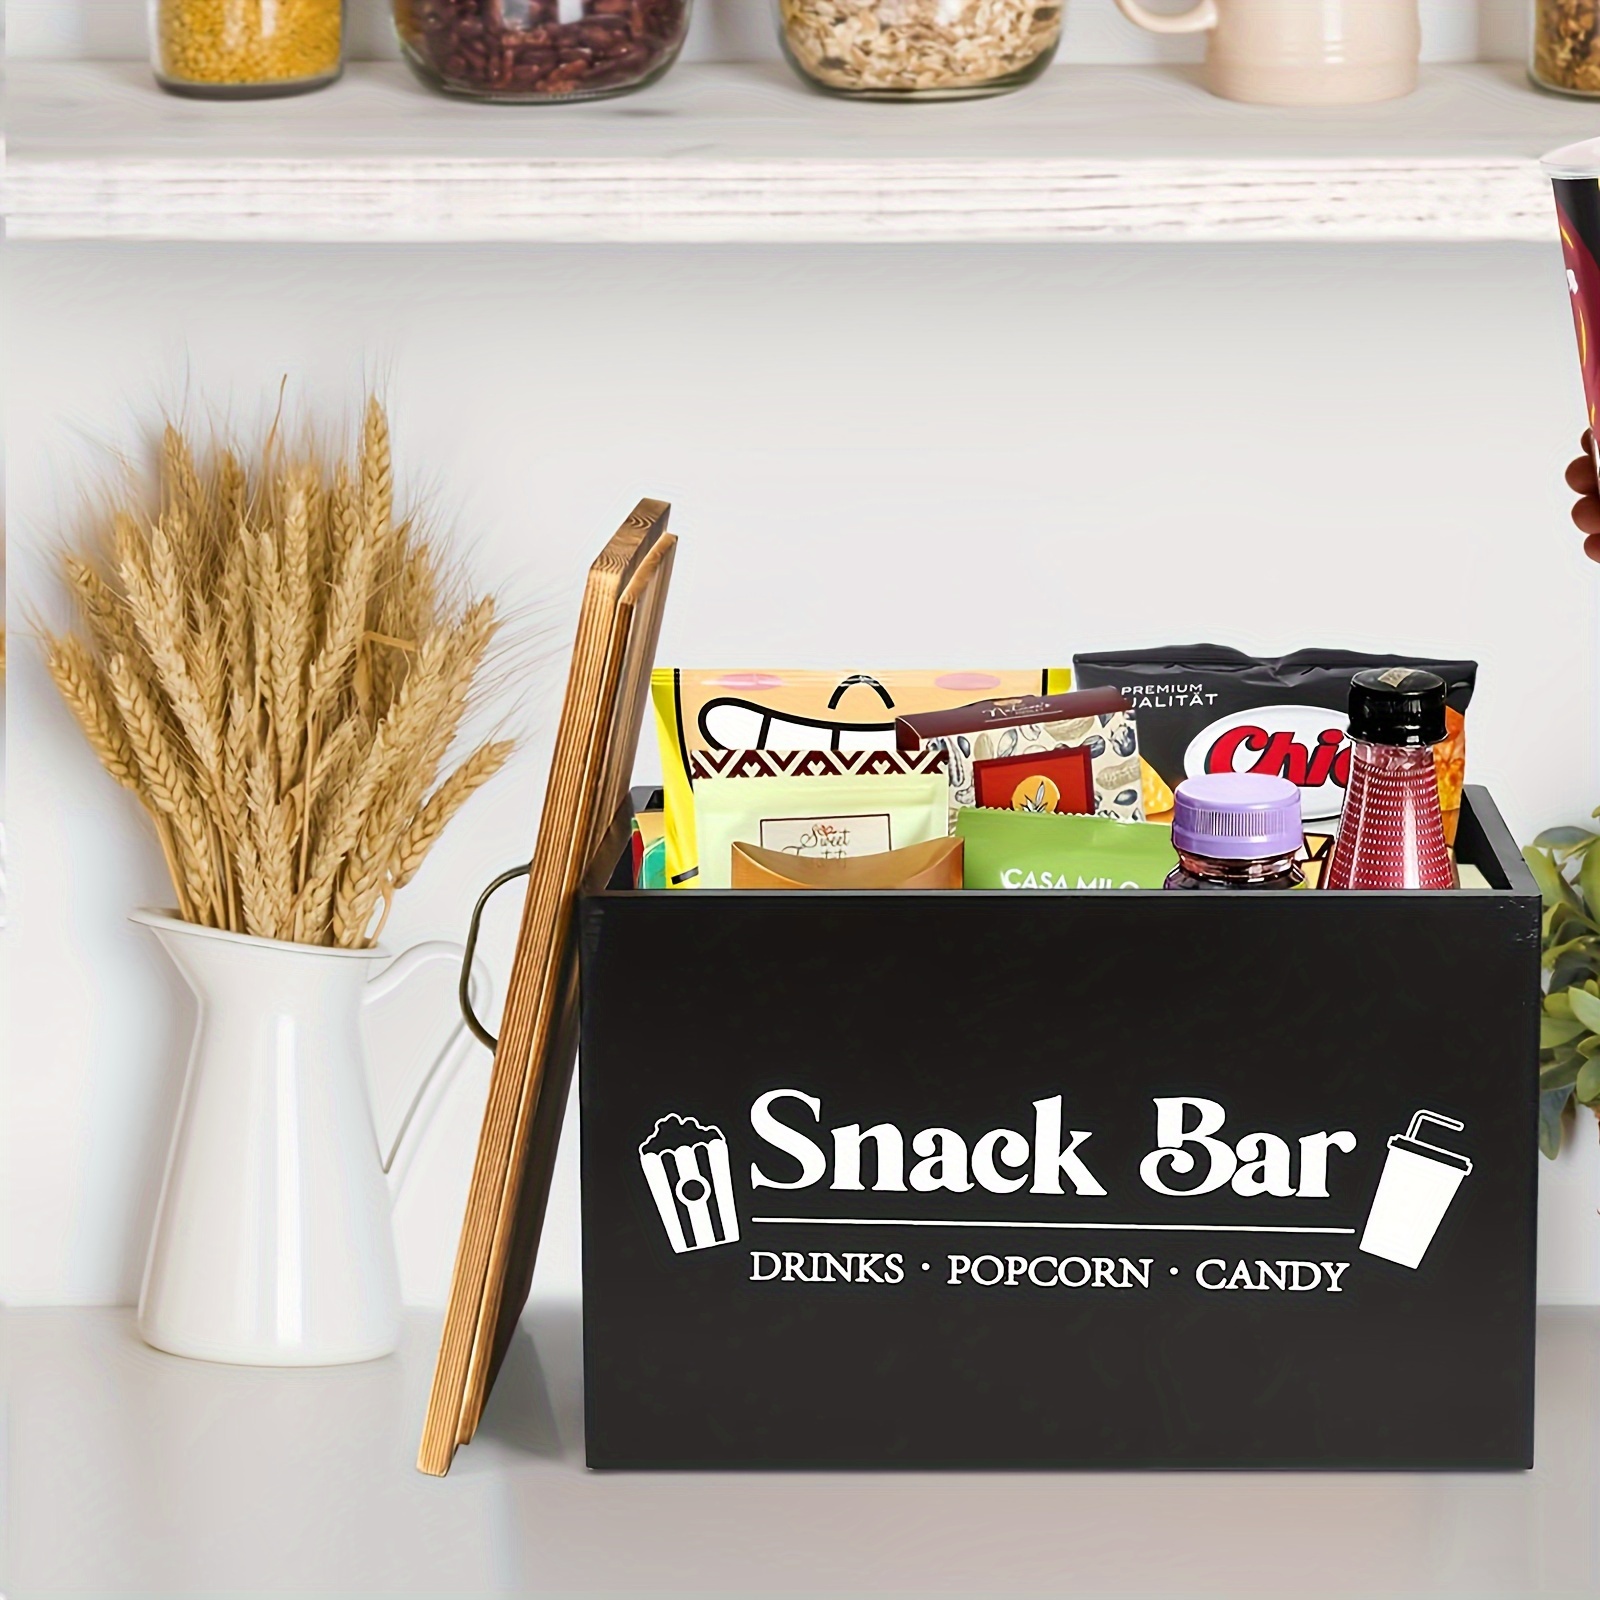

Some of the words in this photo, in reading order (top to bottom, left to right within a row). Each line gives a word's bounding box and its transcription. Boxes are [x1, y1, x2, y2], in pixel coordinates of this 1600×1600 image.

[1121, 683, 1203, 696] PREMIUM
[1131, 692, 1219, 708] ALITÄT
[800, 823, 851, 849] Sweet
[1003, 868, 1069, 889] CASA
[750, 1088, 1108, 1196] Snack
[1139, 1096, 1357, 1198] Bar
[749, 1251, 906, 1285] DRINKS
[946, 1253, 1154, 1290] POPCORN
[1194, 1257, 1351, 1293] CANDY
